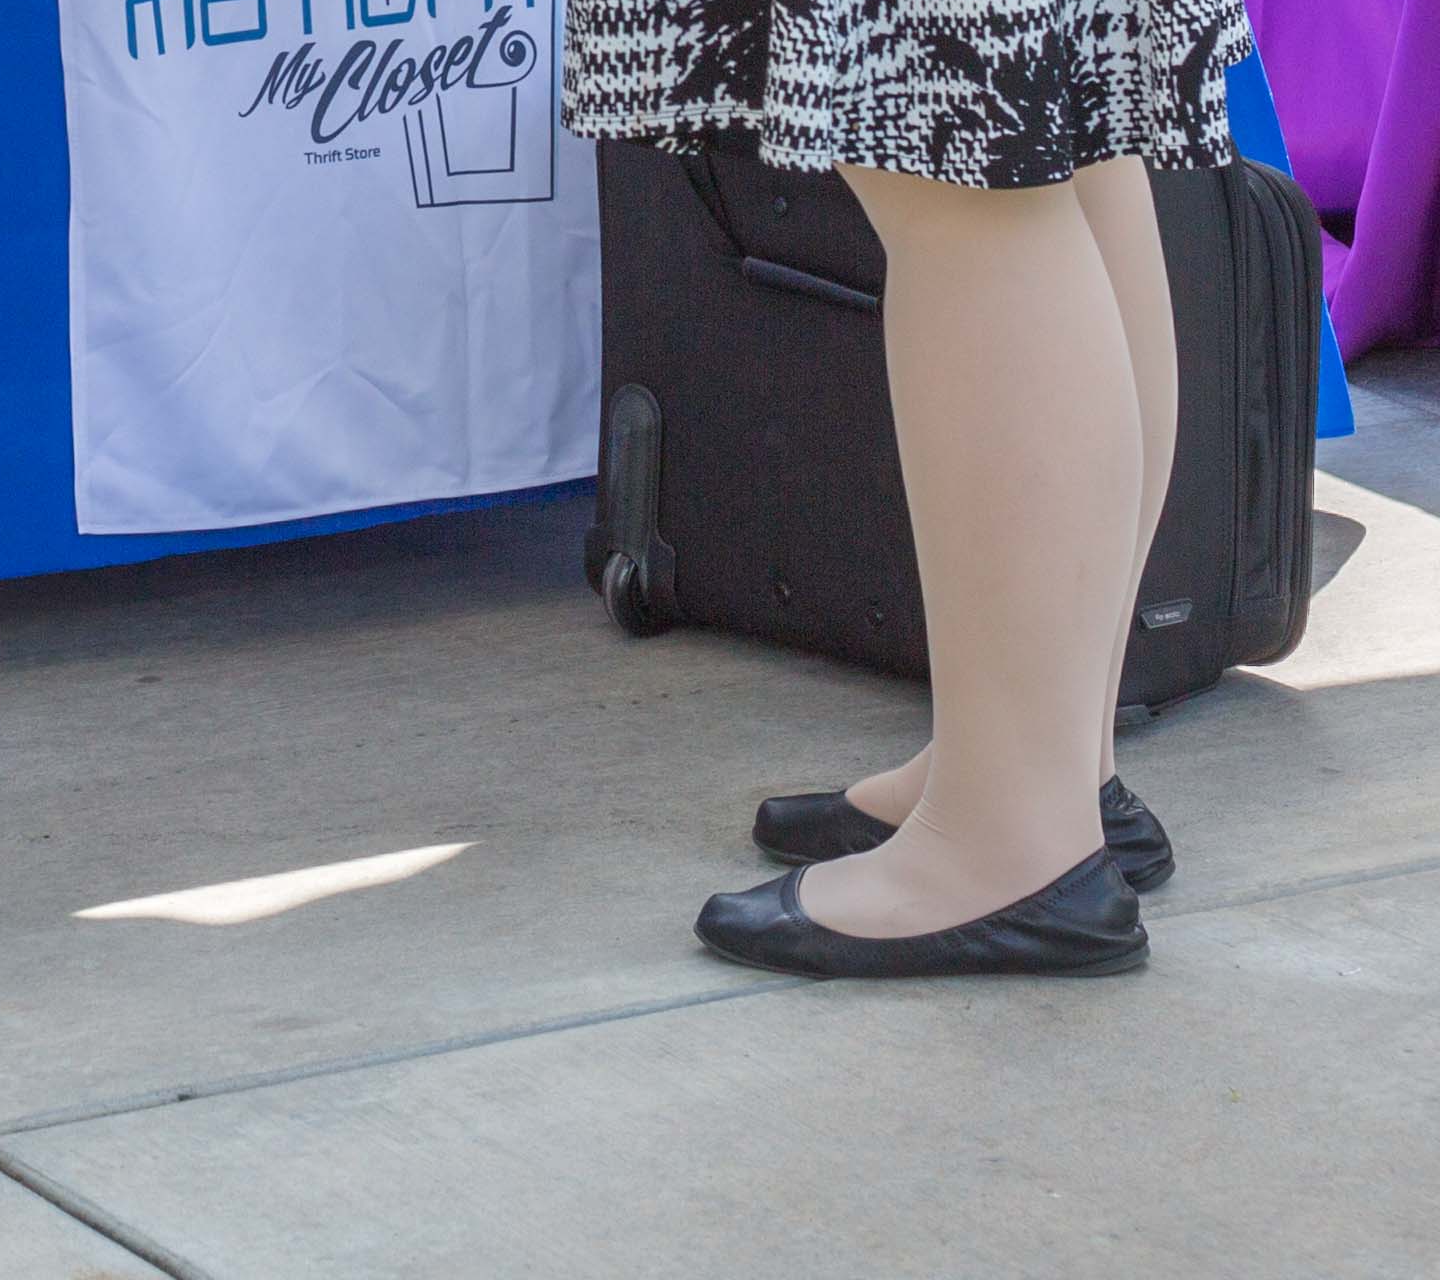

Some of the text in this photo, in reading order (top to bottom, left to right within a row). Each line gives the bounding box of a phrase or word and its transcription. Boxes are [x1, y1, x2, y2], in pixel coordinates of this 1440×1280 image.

[238, 5, 514, 144] My Closet
[304, 146, 381, 165] Thrift Store
